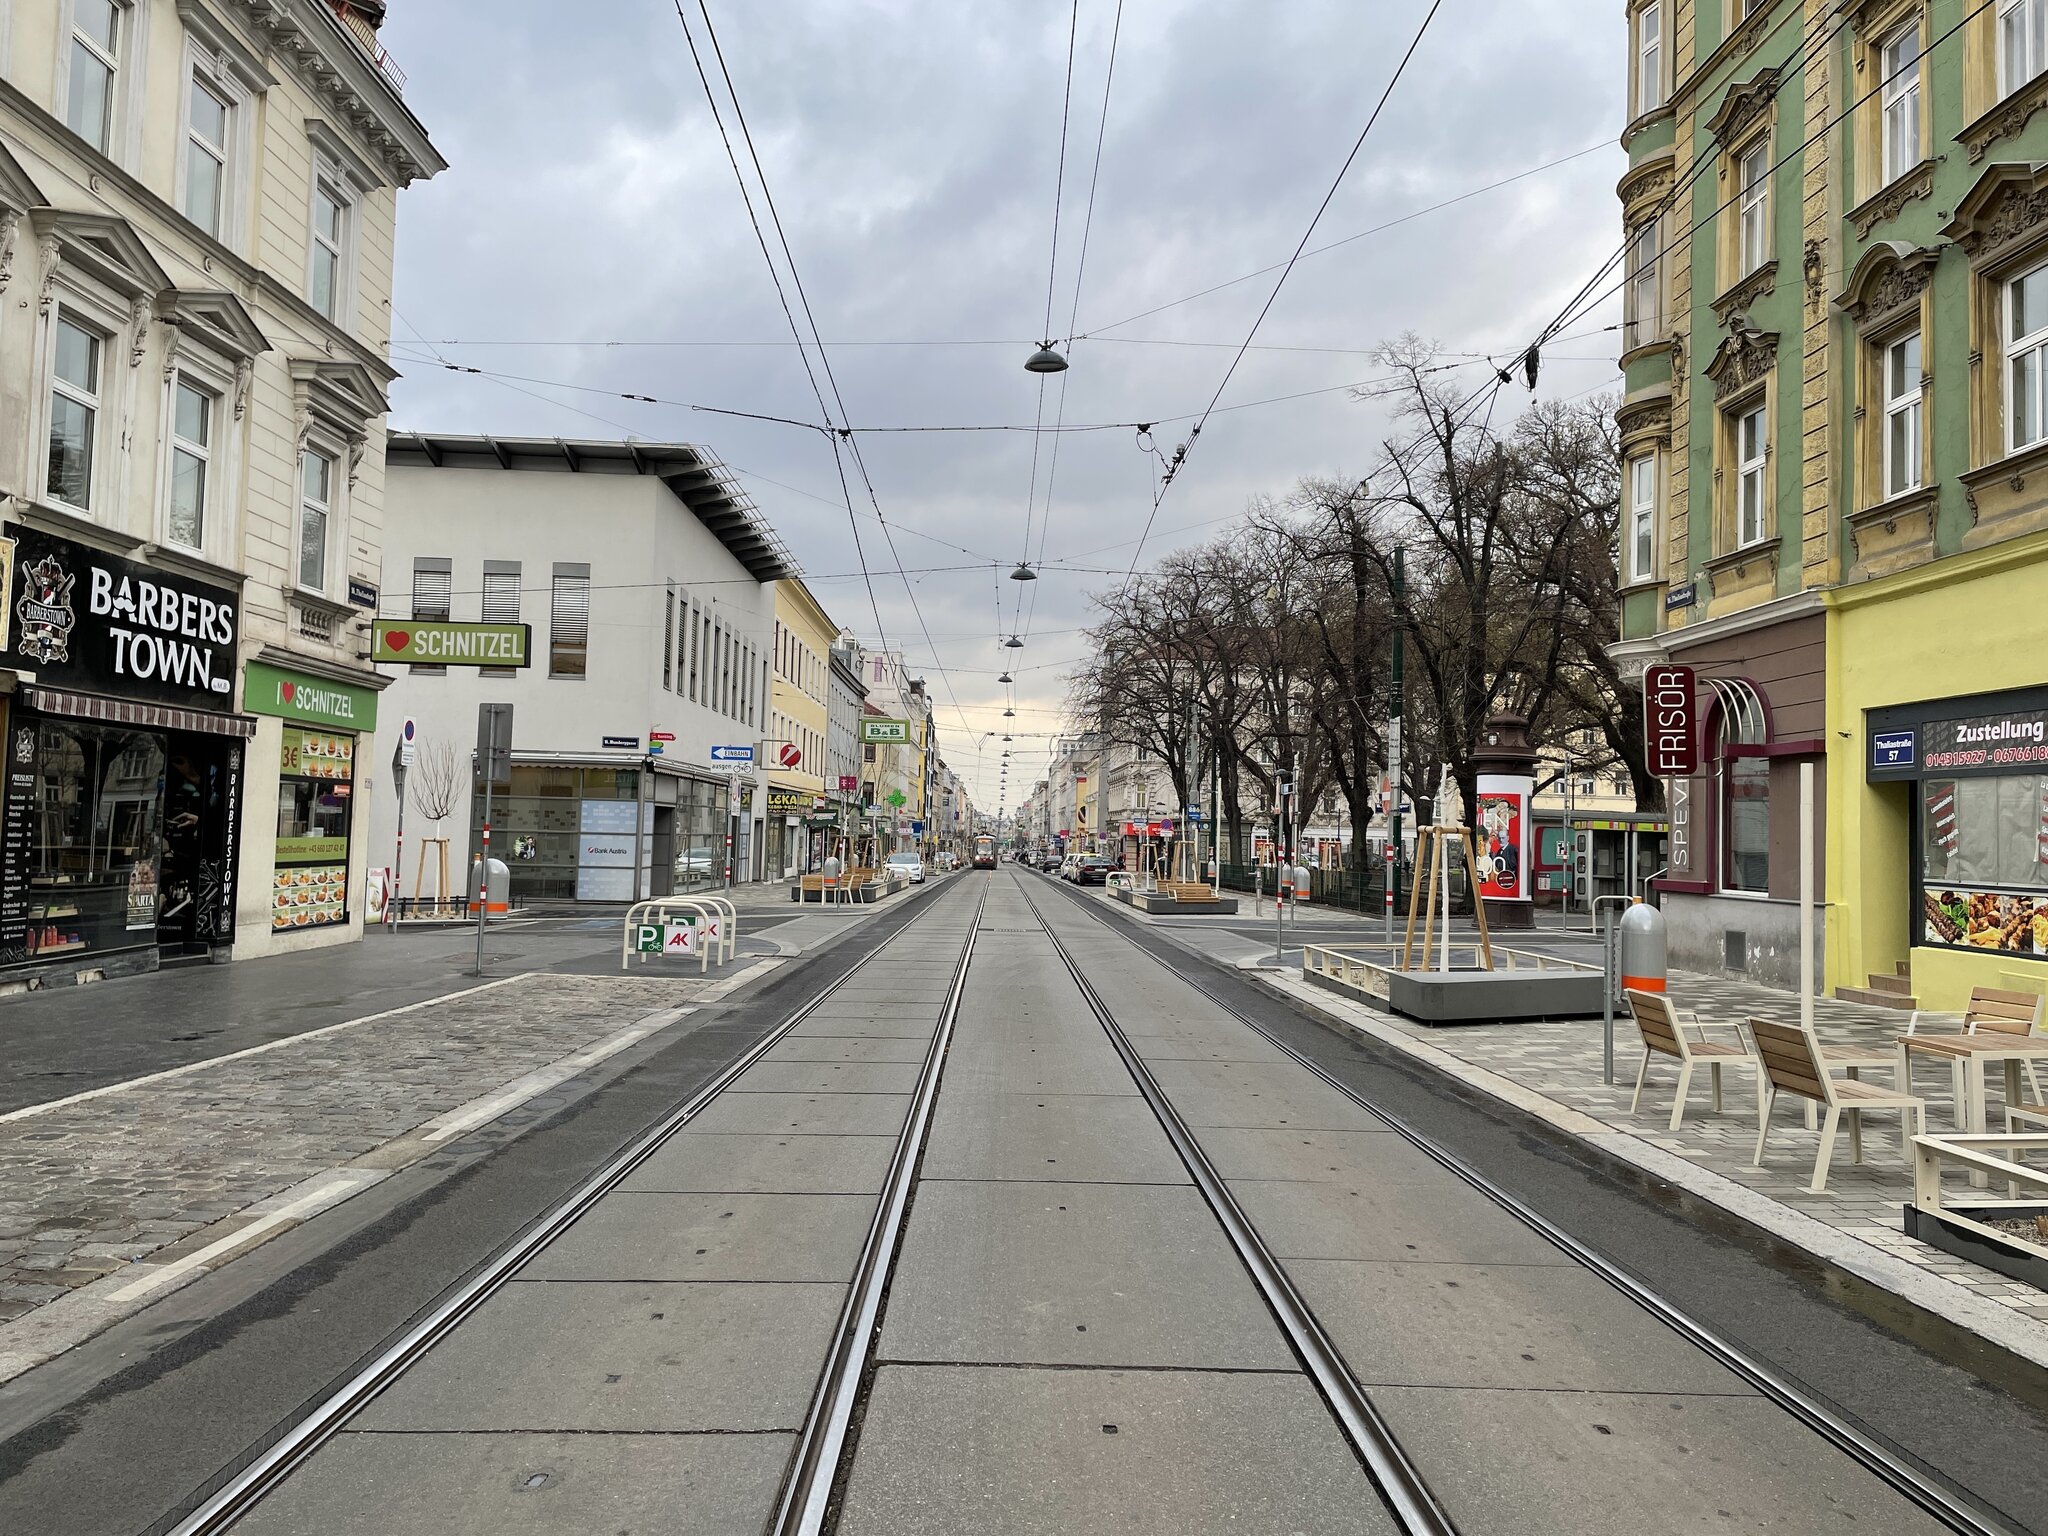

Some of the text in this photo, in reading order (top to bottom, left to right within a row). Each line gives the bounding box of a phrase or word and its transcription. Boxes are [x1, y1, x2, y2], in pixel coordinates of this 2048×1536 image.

[26, 602, 67, 625] BARBERSTOWN
[90, 566, 233, 645] BARBERS
[375, 629, 523, 658] I SCHNITZEL
[109, 627, 213, 690] TOWN
[276, 681, 354, 718] I SCHNITZEL
[870, 728, 900, 736] B&B
[1654, 672, 1687, 769] FRISÖR
[1956, 720, 2044, 743] Zustellung
[1876, 739, 1912, 750] Thaliastraße
[1888, 750, 1899, 761] 57
[1925, 750, 1987, 767] 014315927
[1993, 745, 2048, 763] 0676618
[282, 746, 298, 768] 3€
[768, 794, 797, 805] LEKA
[222, 773, 237, 906] BARBERSTOWN
[608, 847, 627, 855] Austria
[637, 926, 658, 950] P
[668, 933, 689, 946] AK
